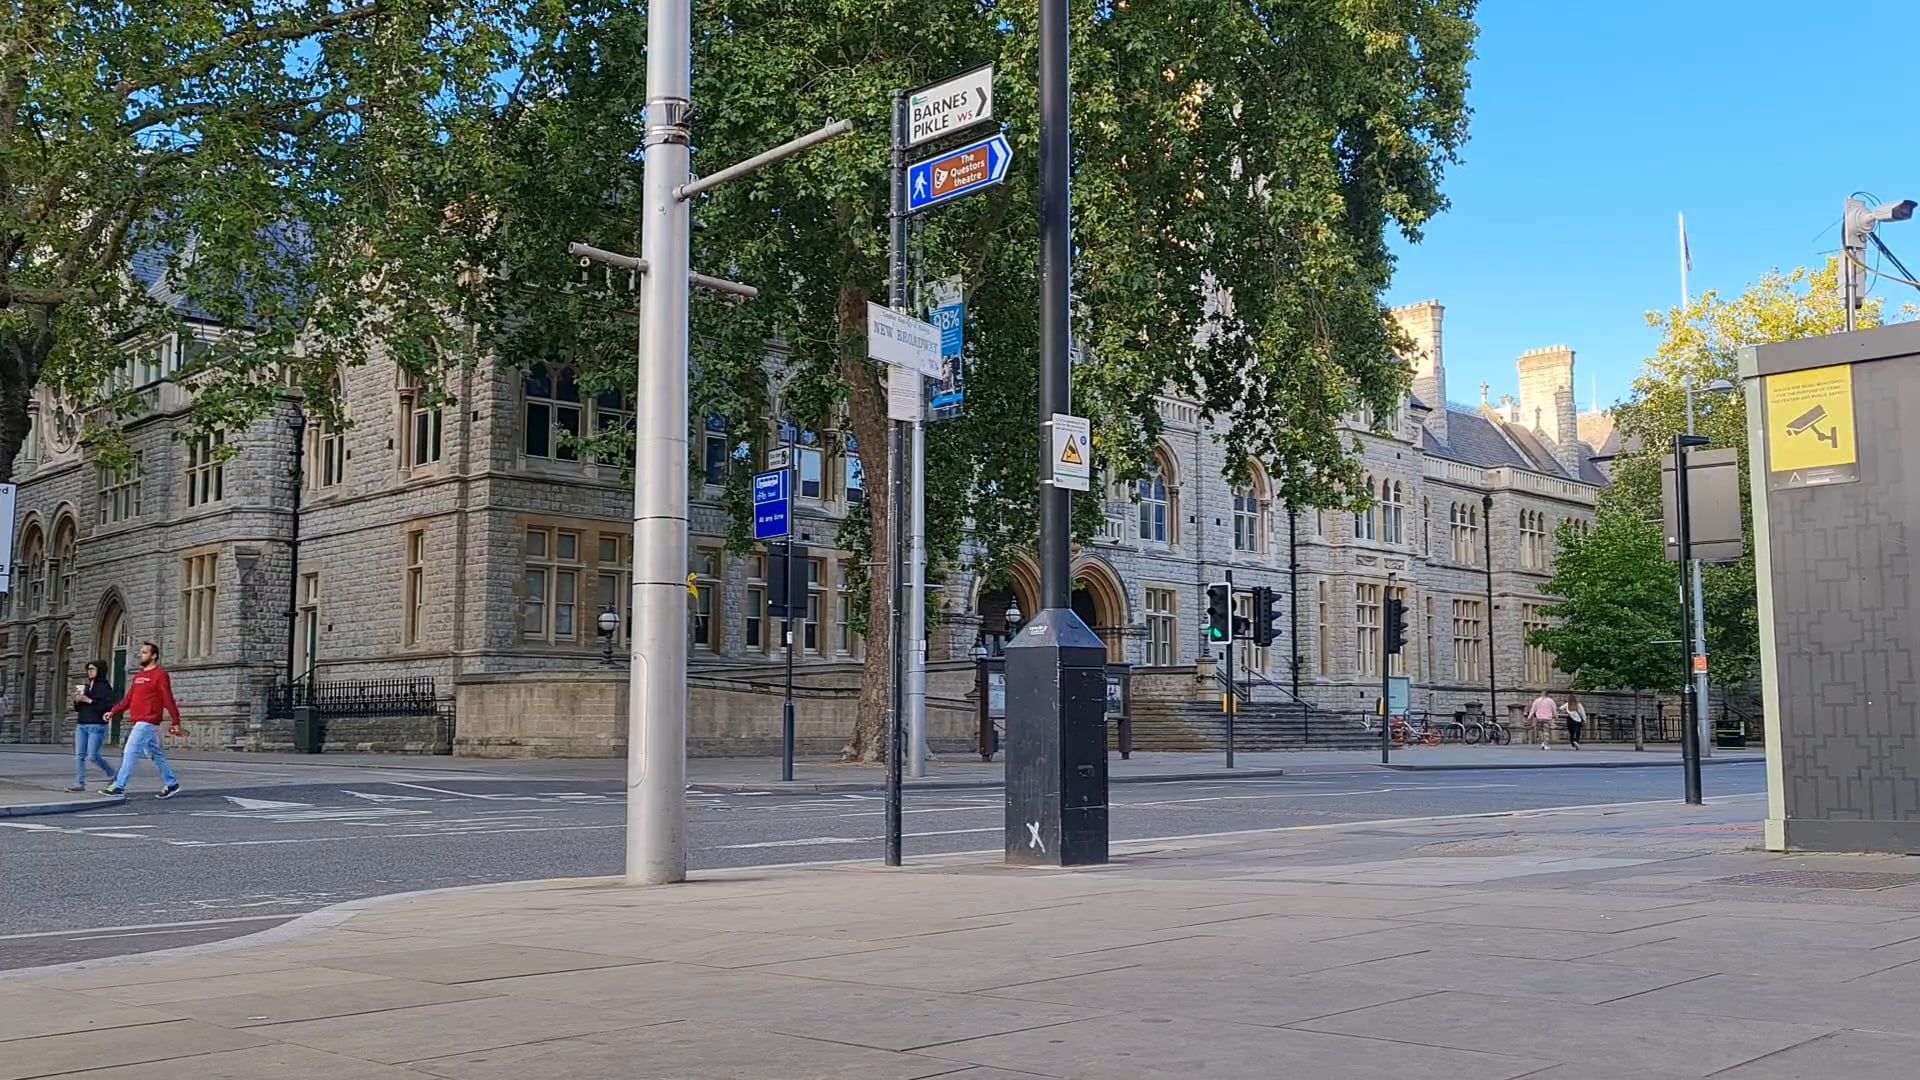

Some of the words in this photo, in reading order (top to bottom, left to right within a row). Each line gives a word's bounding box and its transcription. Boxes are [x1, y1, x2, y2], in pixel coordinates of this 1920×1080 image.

[914, 91, 967, 122] BARNES
[914, 113, 949, 138] PIKLE
[950, 160, 985, 178] Questors
[961, 153, 974, 164] The
[954, 172, 982, 187] theatre
[874, 321, 893, 338] NEW
[897, 329, 938, 353] BROADWAY
